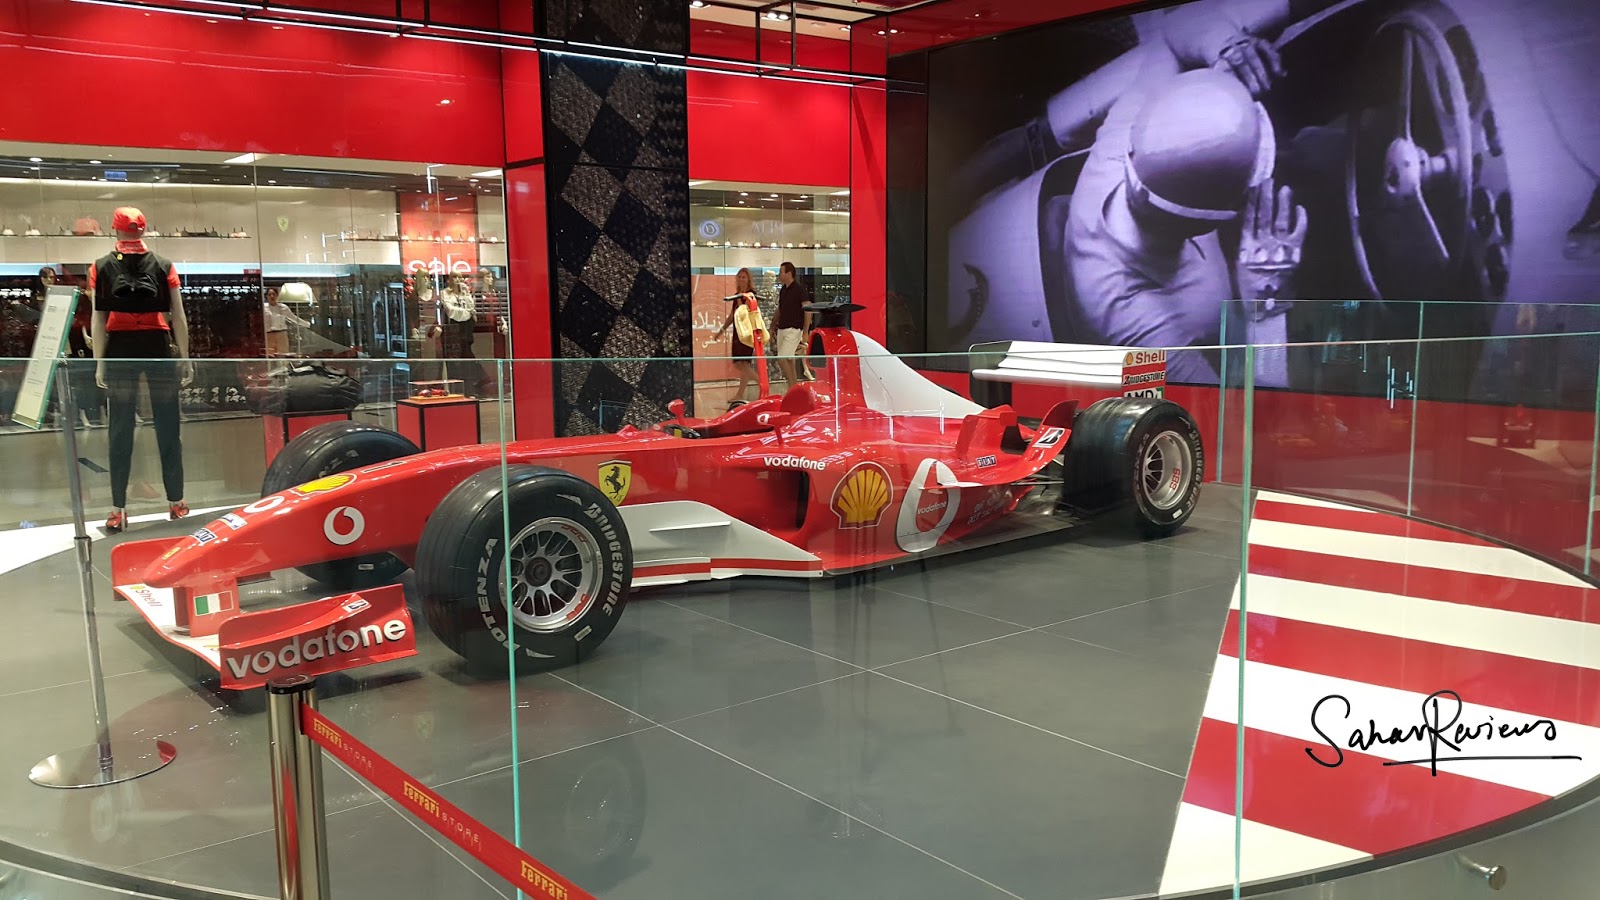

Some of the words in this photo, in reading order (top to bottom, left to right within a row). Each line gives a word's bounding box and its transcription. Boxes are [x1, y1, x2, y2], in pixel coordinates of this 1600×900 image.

[1135, 350, 1165, 364] Shell
[1123, 371, 1165, 385] BRIDGESTONE
[763, 456, 826, 471] vodafone
[977, 455, 997, 469] FIAT
[917, 501, 948, 514] vodafone
[584, 502, 624, 617] BRIDGESTONE
[126, 589, 163, 607] Shell
[227, 619, 407, 679] vodafone
[313, 718, 342, 749] Ferrari
[343, 743, 373, 769] STORE
[403, 781, 440, 818] Ferrari
[441, 811, 480, 844] STORE
[520, 860, 568, 900] Ferrari
